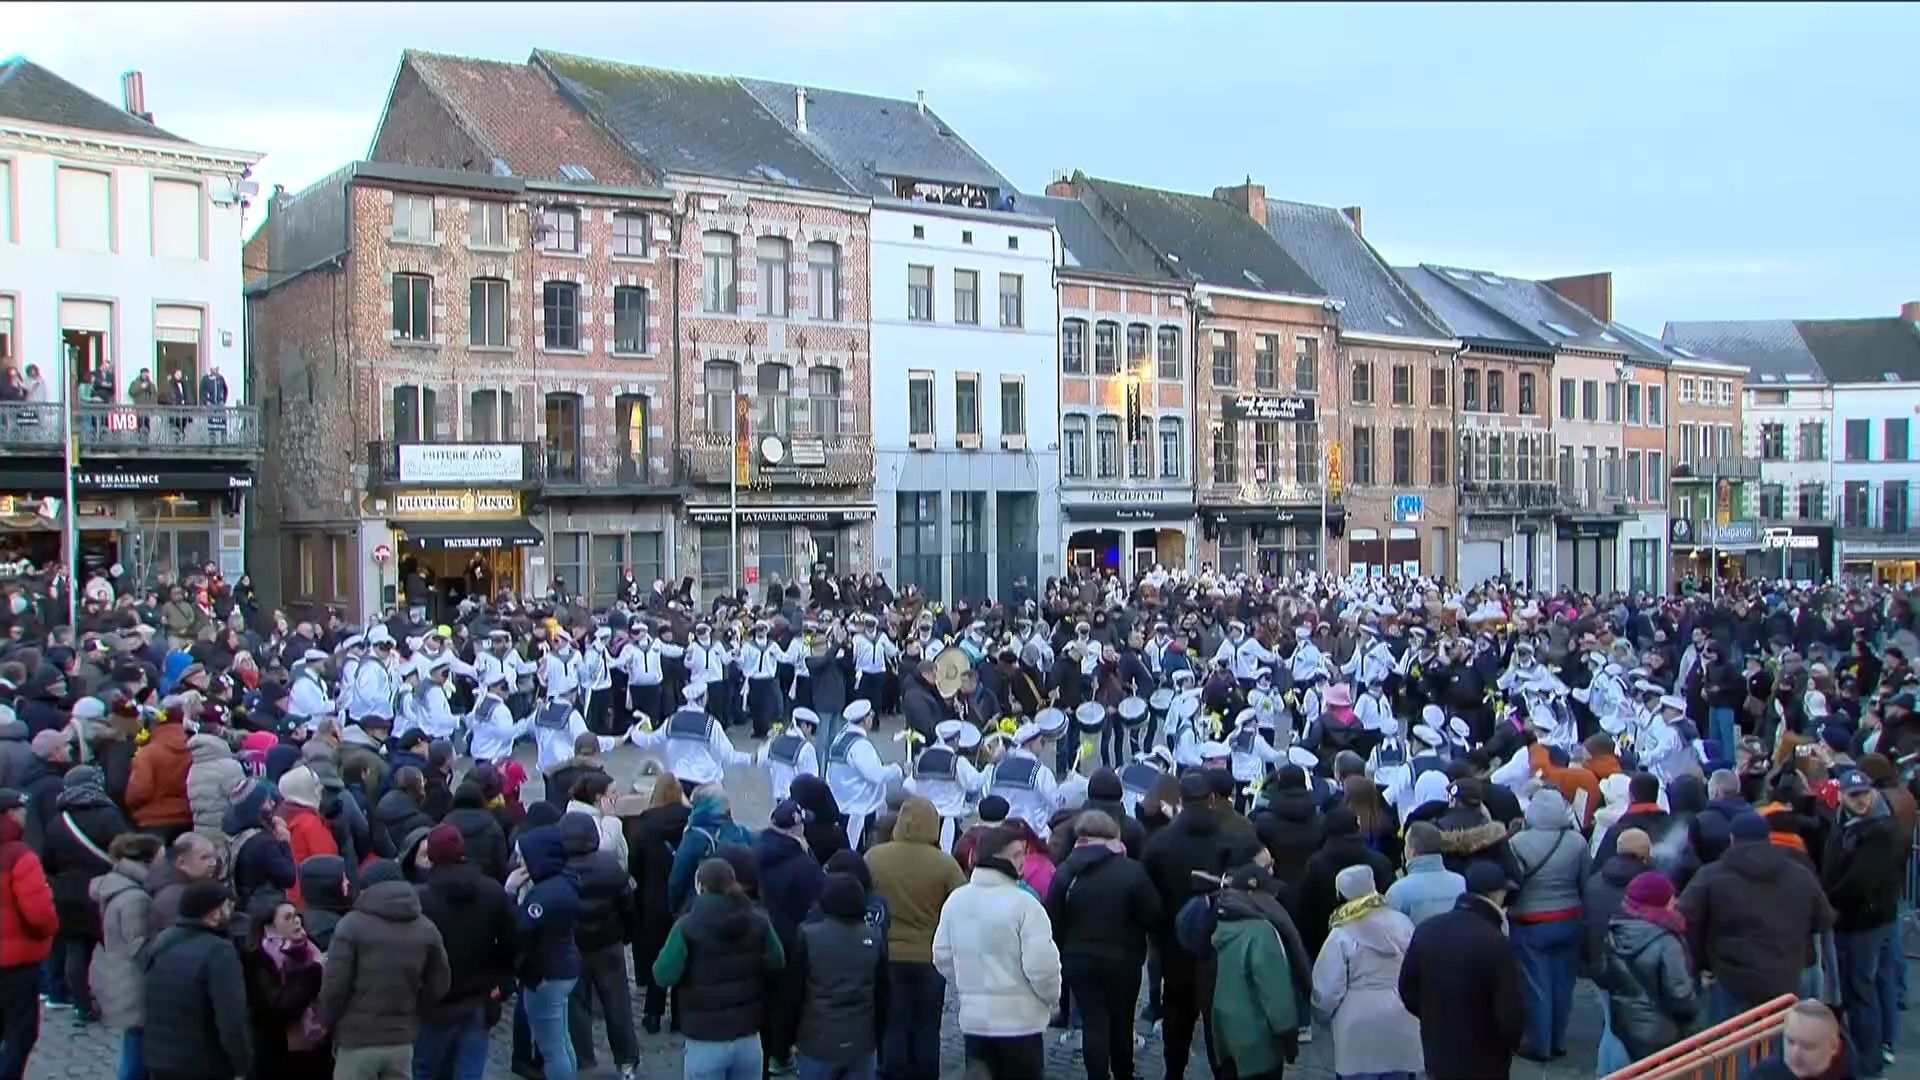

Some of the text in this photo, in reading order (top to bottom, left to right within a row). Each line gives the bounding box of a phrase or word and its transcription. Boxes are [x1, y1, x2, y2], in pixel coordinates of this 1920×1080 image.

[78, 474, 160, 484] LA RENAISSANCE
[229, 476, 252, 487] Duvel
[742, 513, 753, 521] LA
[1720, 525, 1752, 539] Diapason
